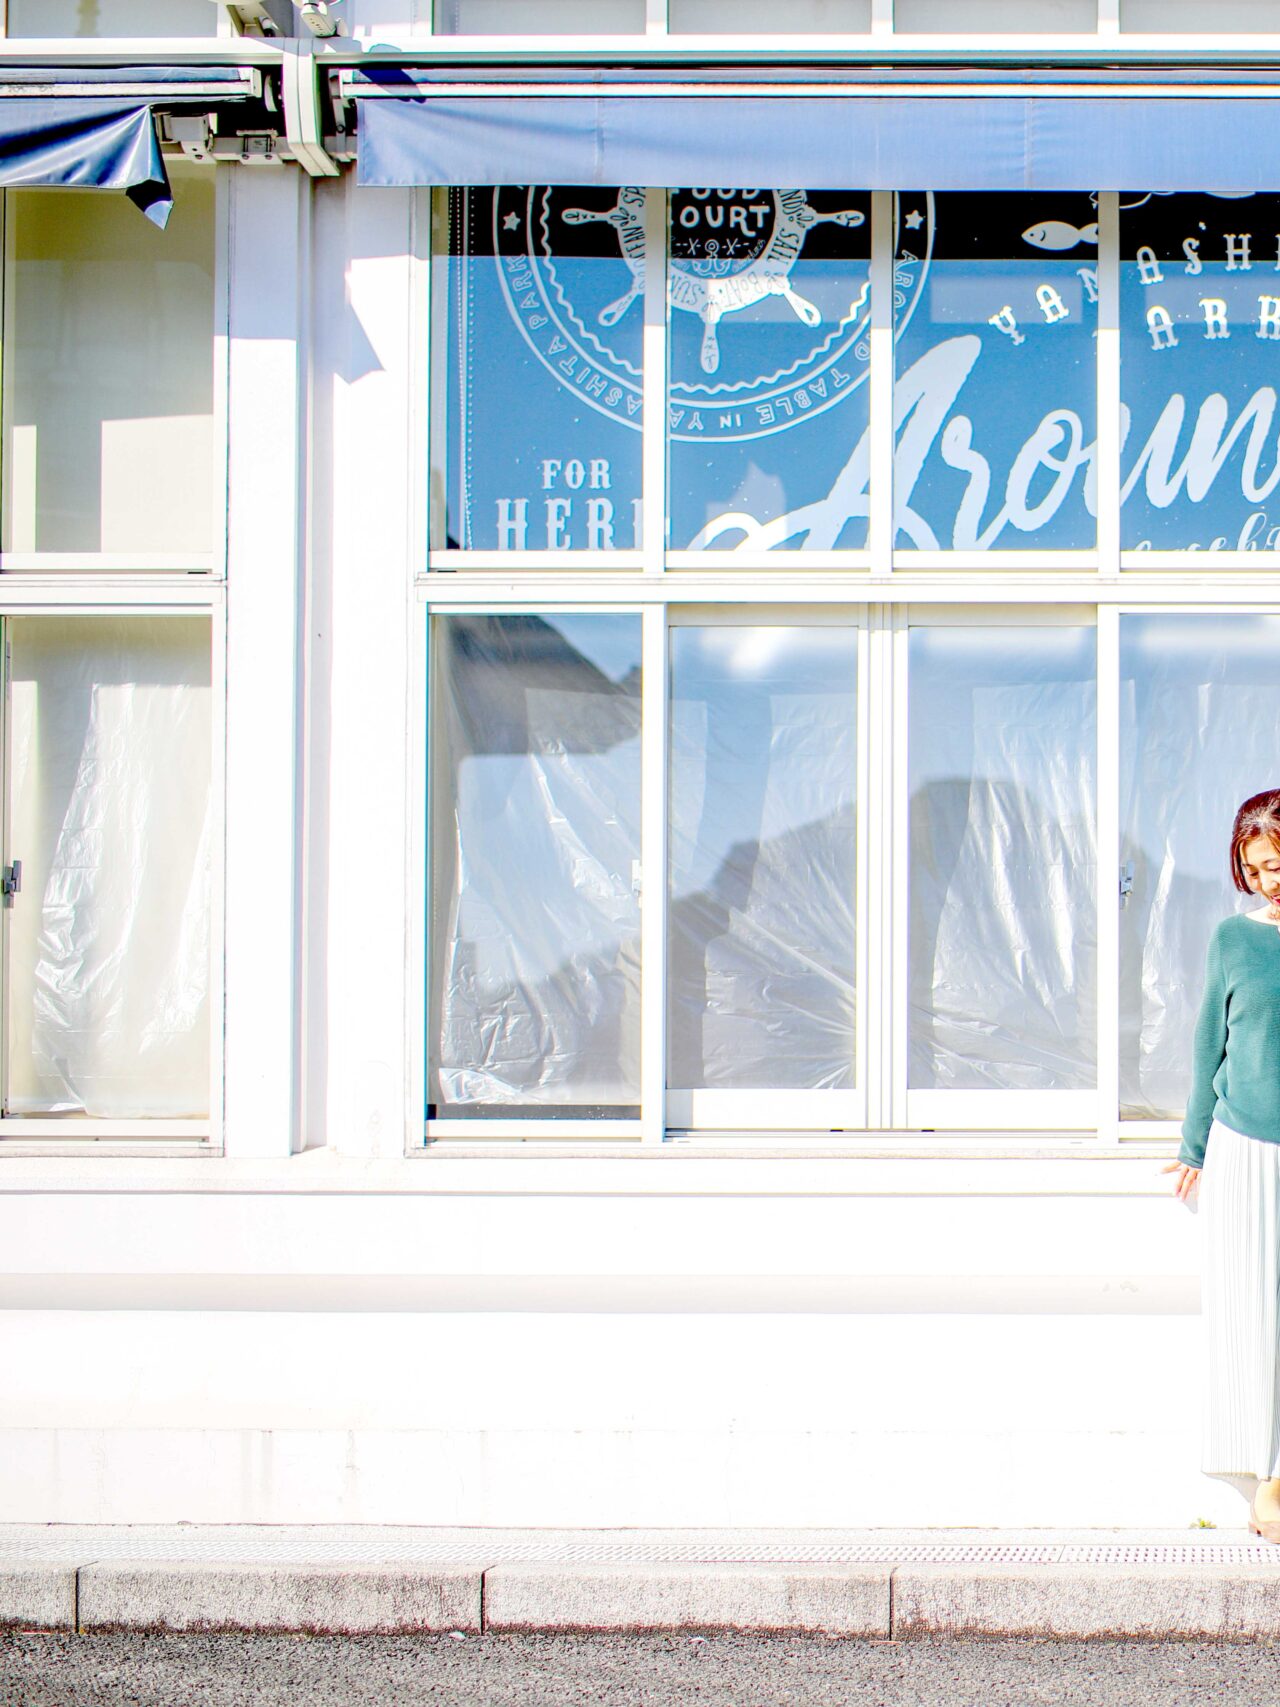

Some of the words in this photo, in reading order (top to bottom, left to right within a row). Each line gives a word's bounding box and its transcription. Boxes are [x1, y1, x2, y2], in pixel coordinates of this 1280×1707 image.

[678, 205, 771, 238] OURT
[506, 253, 549, 331] PARK
[548, 335, 704, 431] YAASHITA
[756, 367, 850, 425] TABLE
[719, 411, 742, 431] IN
[541, 458, 612, 490] FOR
